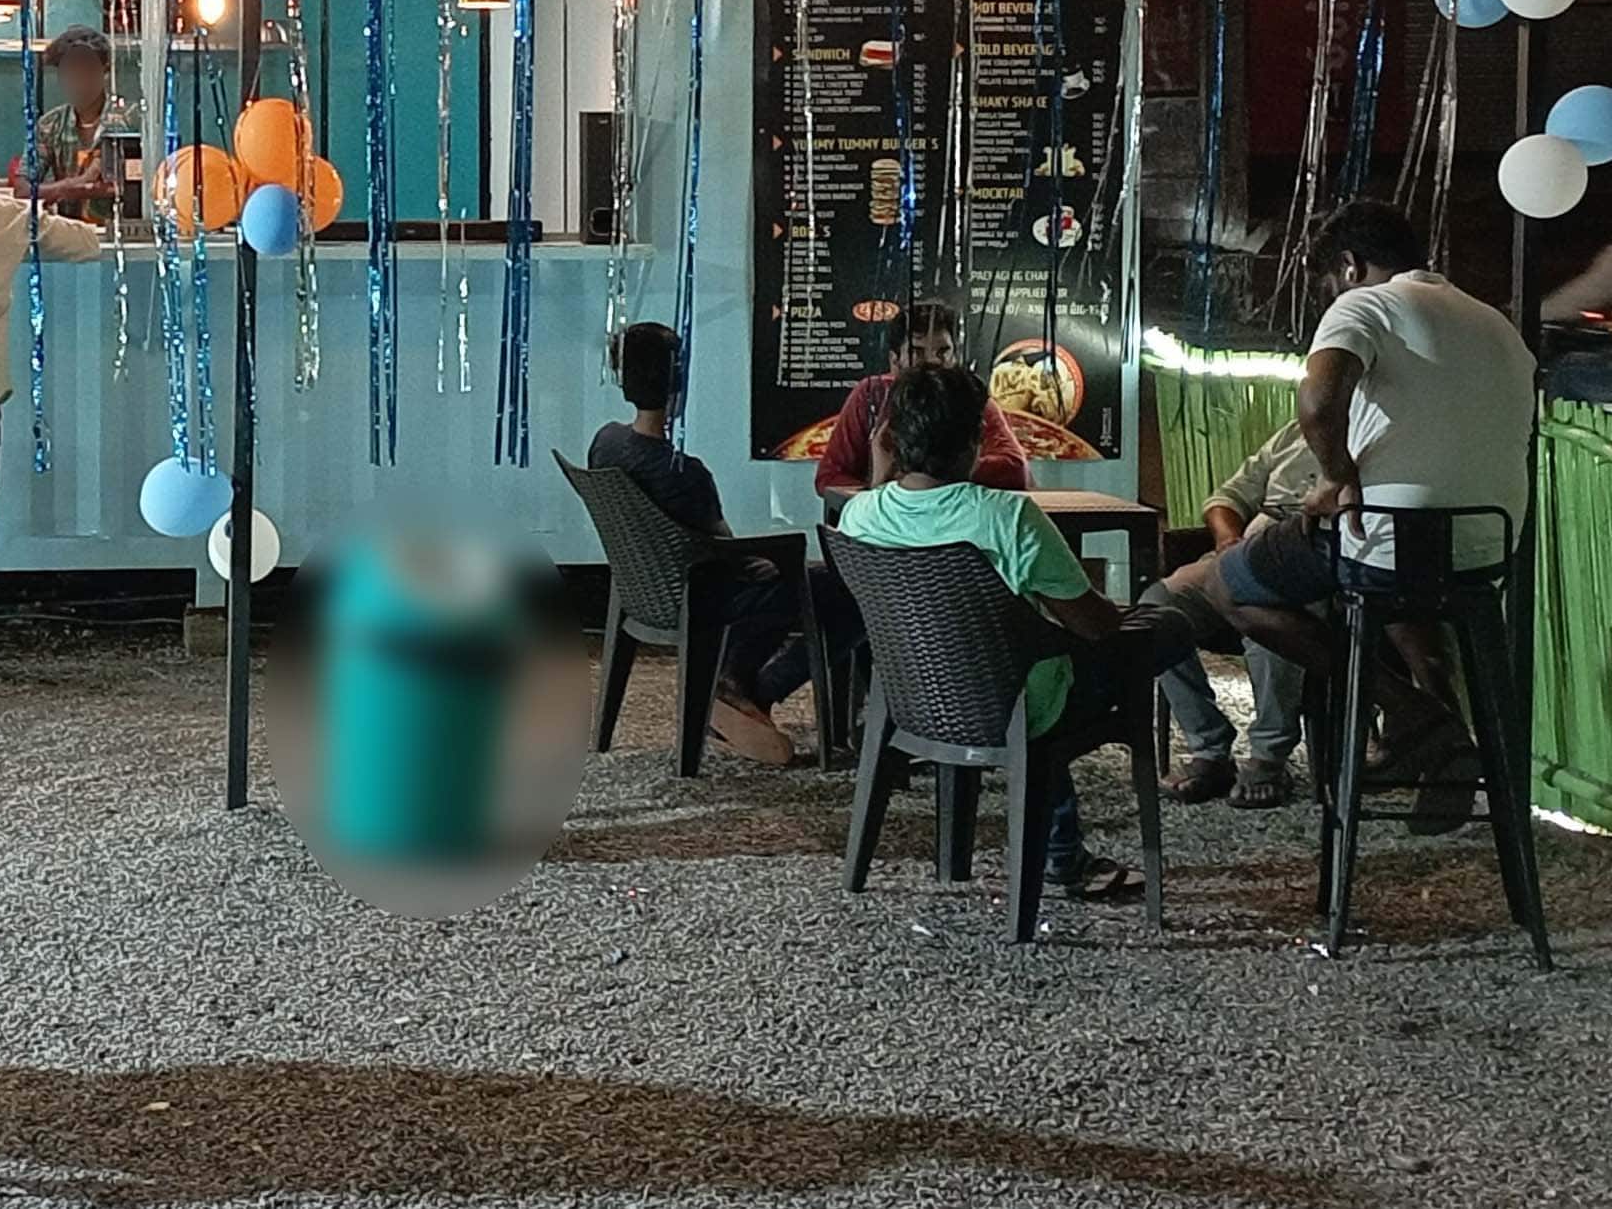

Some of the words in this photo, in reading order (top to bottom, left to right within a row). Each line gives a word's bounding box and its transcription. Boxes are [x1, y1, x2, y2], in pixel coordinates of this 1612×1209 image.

[792, 137, 836, 151] YUMY
[838, 137, 880, 151] TUMMY
[970, 270, 1023, 282] PACAGIG
